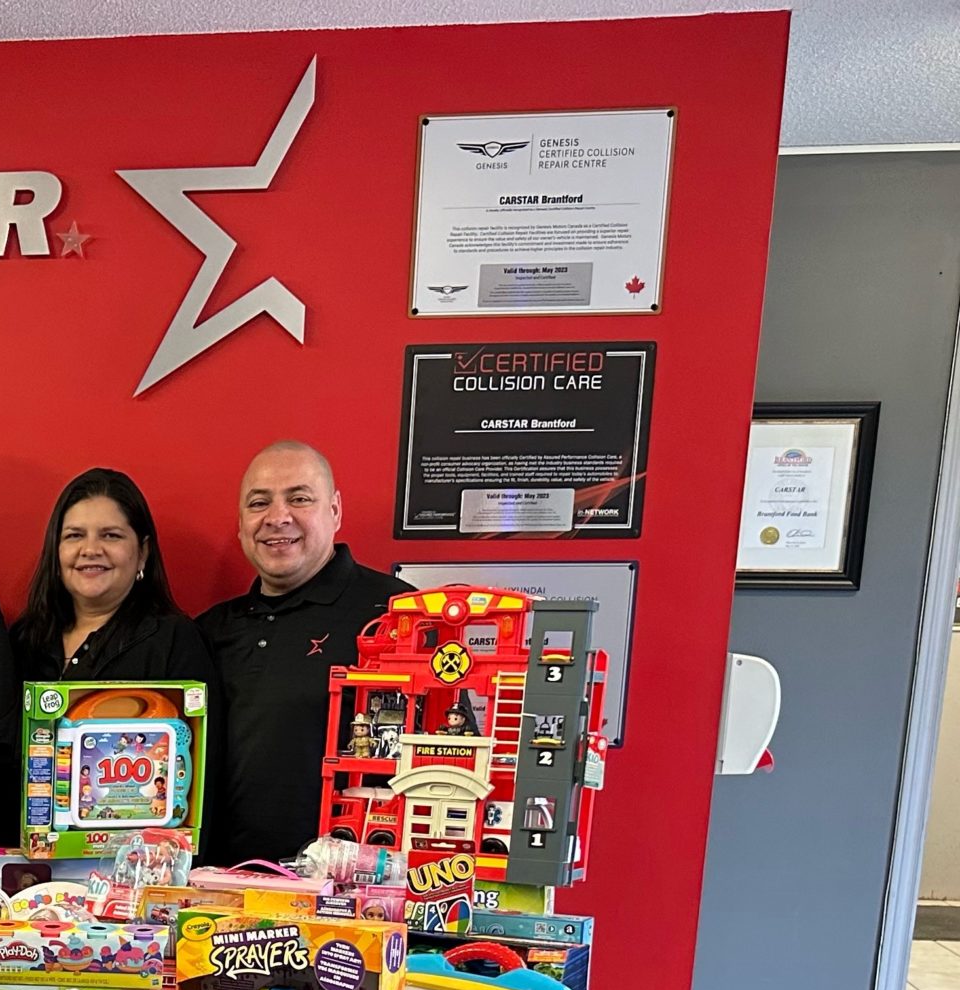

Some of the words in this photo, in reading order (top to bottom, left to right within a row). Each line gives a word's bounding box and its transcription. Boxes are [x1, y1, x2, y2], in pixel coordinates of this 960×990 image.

[540, 139, 579, 147] GENESIS
[539, 149, 584, 158] CERTIFIED
[587, 148, 635, 157] COLLISION
[539, 160, 569, 169] REPAIR
[572, 159, 607, 168] CENTRE
[499, 195, 538, 205] CARSTAR
[541, 194, 583, 204] Brantford
[480, 352, 604, 373] CERTIFIED
[453, 375, 545, 391] COLLISION
[554, 375, 603, 390] CARE
[481, 419, 528, 429] CARSTAR
[531, 418, 576, 428] Brantford
[547, 666, 561, 681] 3
[42, 694, 58, 702] Leap
[44, 701, 60, 710] Frog
[416, 747, 436, 755] FIRE
[438, 747, 473, 756] STATION
[539, 752, 553, 765] 2
[98, 756, 152, 784] 100
[86, 833, 109, 843] 100
[531, 833, 543, 847] 1
[407, 853, 475, 893] UNO
[213, 932, 245, 945] MINI
[247, 926, 298, 941] MARKER
[210, 941, 309, 978] SPRAYERS
